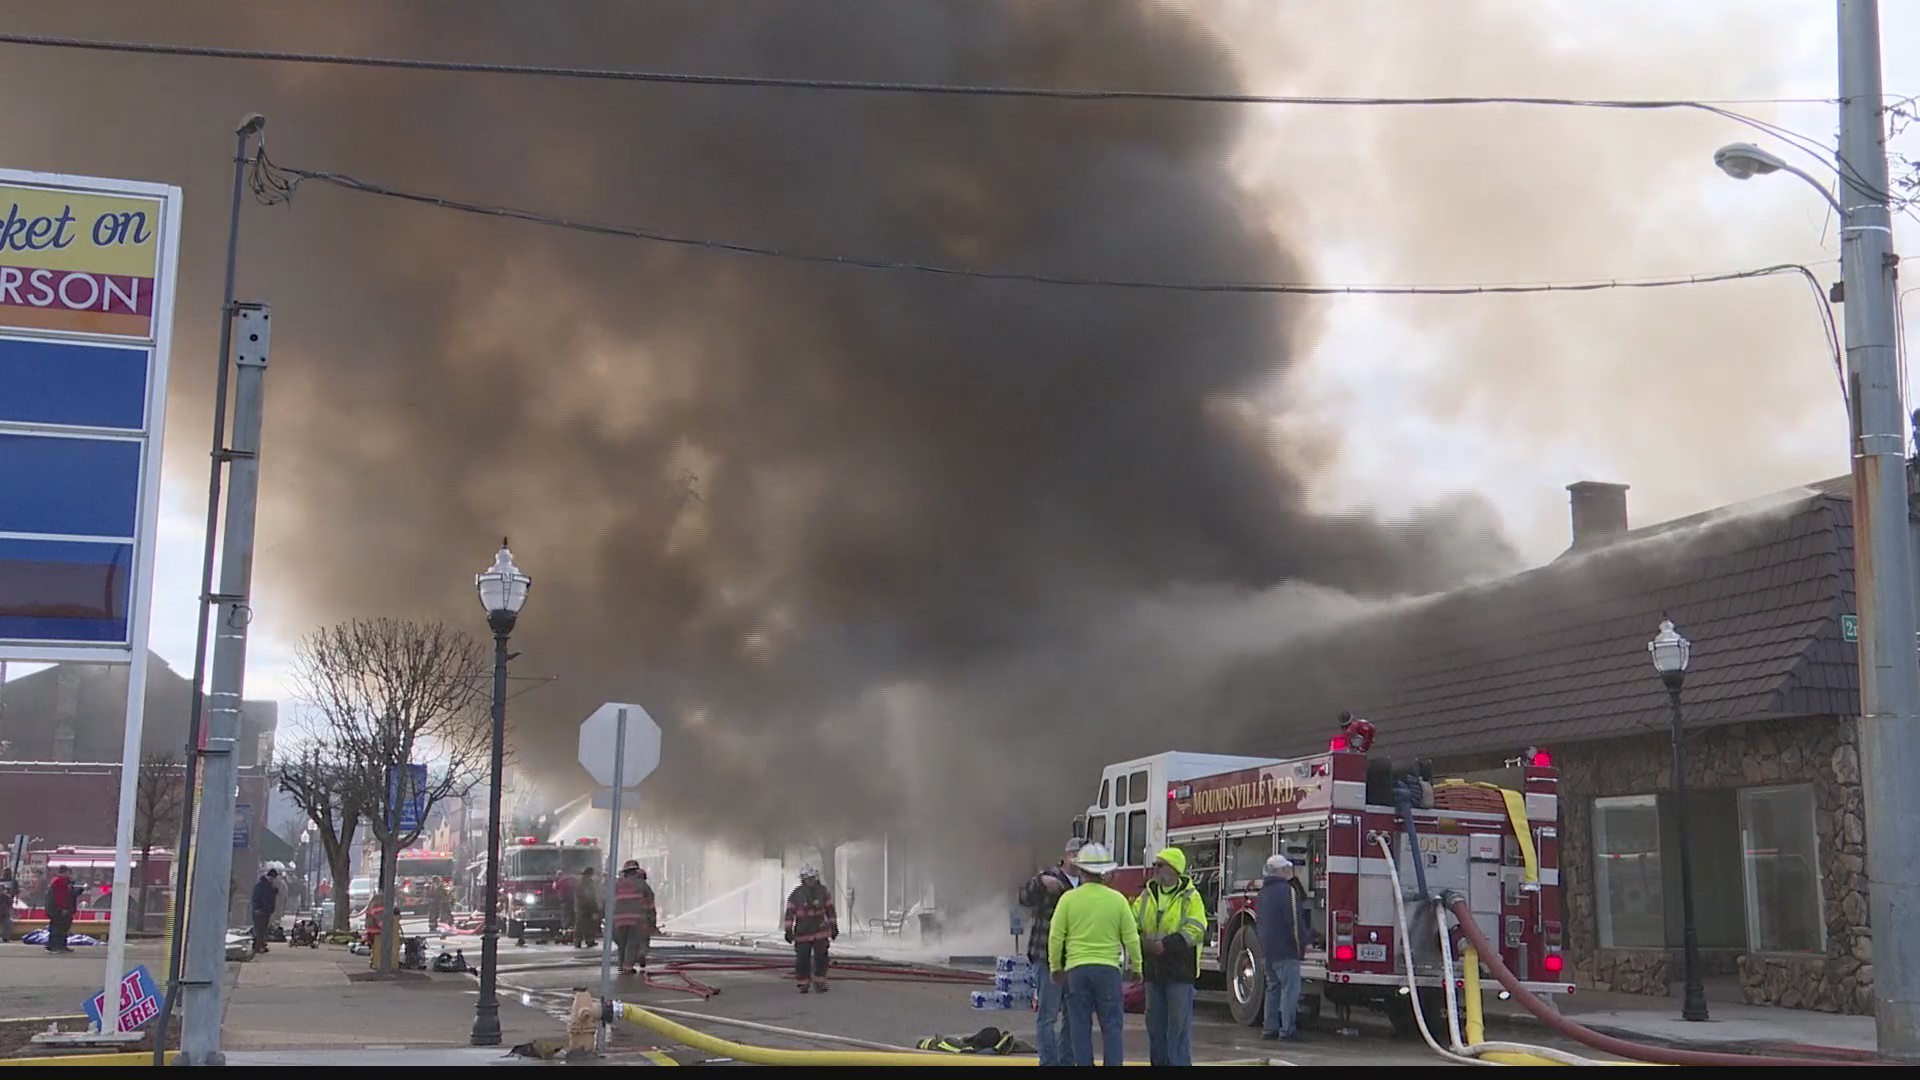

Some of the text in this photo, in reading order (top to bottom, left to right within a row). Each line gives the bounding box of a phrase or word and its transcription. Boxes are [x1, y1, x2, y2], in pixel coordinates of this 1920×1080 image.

[0, 203, 151, 251] ket on
[0, 266, 139, 313] RSON
[1193, 776, 1296, 815] MOUNDSVILLE V.F.D.
[118, 995, 159, 1033] ERE!
